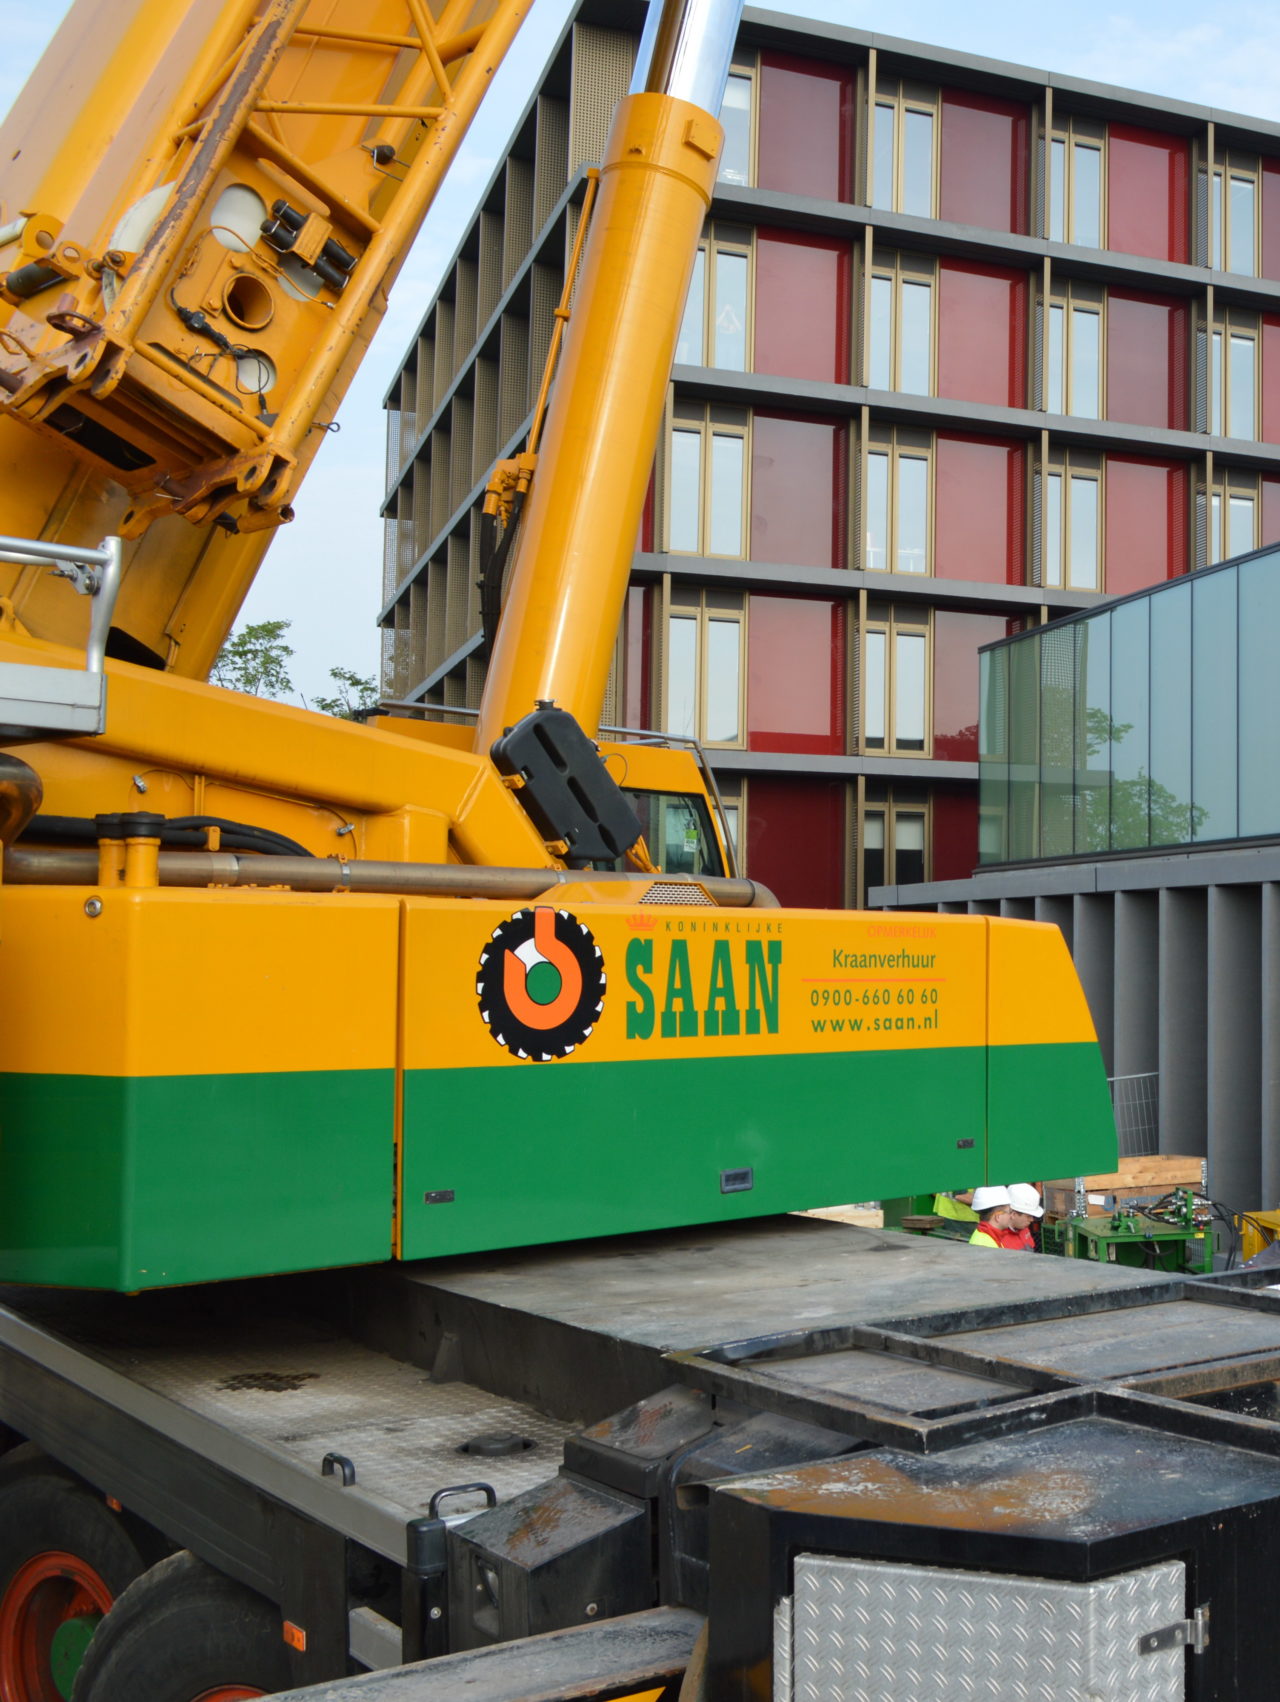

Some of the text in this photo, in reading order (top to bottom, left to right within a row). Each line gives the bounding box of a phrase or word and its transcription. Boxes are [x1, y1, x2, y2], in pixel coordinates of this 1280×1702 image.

[665, 921, 783, 933] KONINKLIJKE
[832, 948, 937, 969] Kraanverhuur
[625, 937, 783, 1040] SAAN
[810, 988, 938, 1007] 0900-660 60 60
[811, 1008, 939, 1033] www.saan.nl
